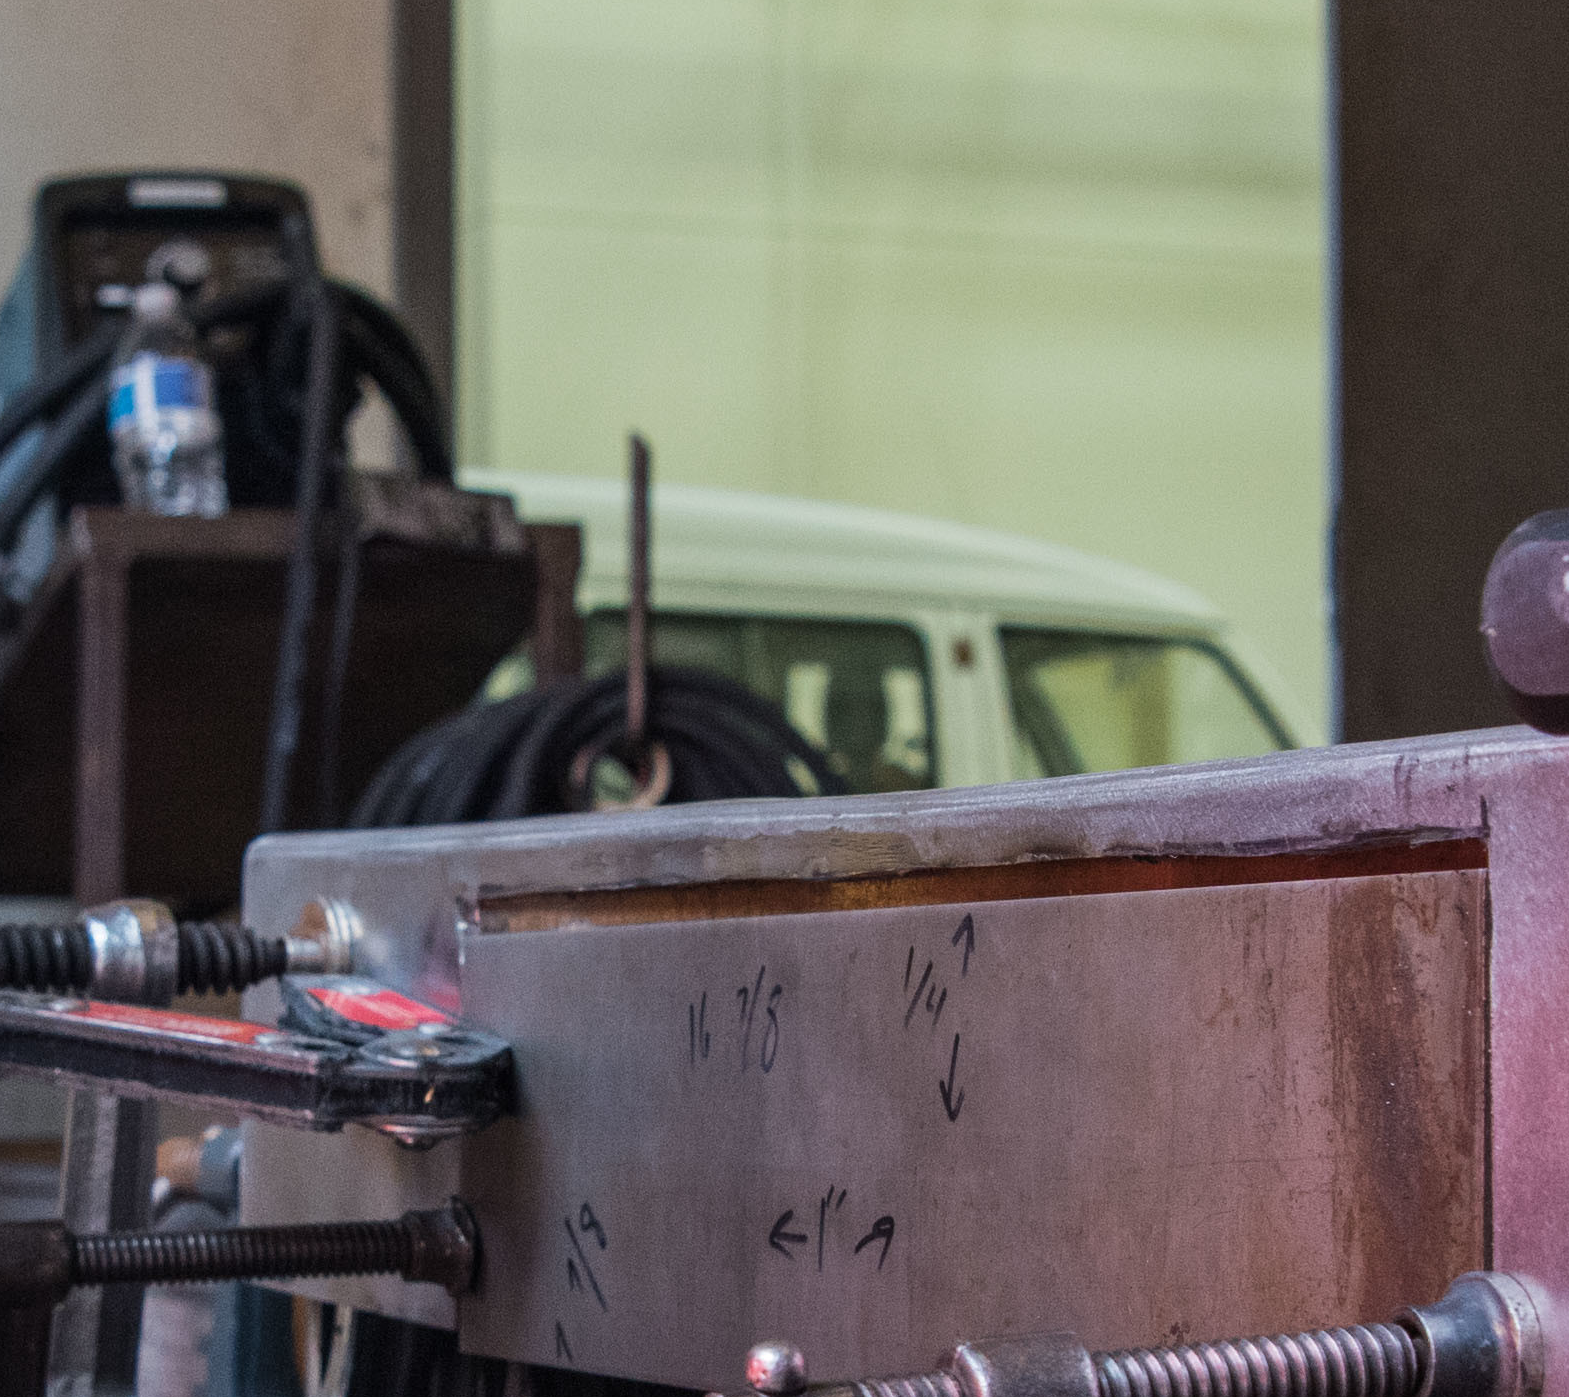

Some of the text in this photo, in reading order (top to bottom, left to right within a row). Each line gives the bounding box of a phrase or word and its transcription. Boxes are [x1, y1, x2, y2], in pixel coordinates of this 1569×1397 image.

[689, 964, 783, 1074] 16 7/8
[904, 944, 947, 1030] 1/4
